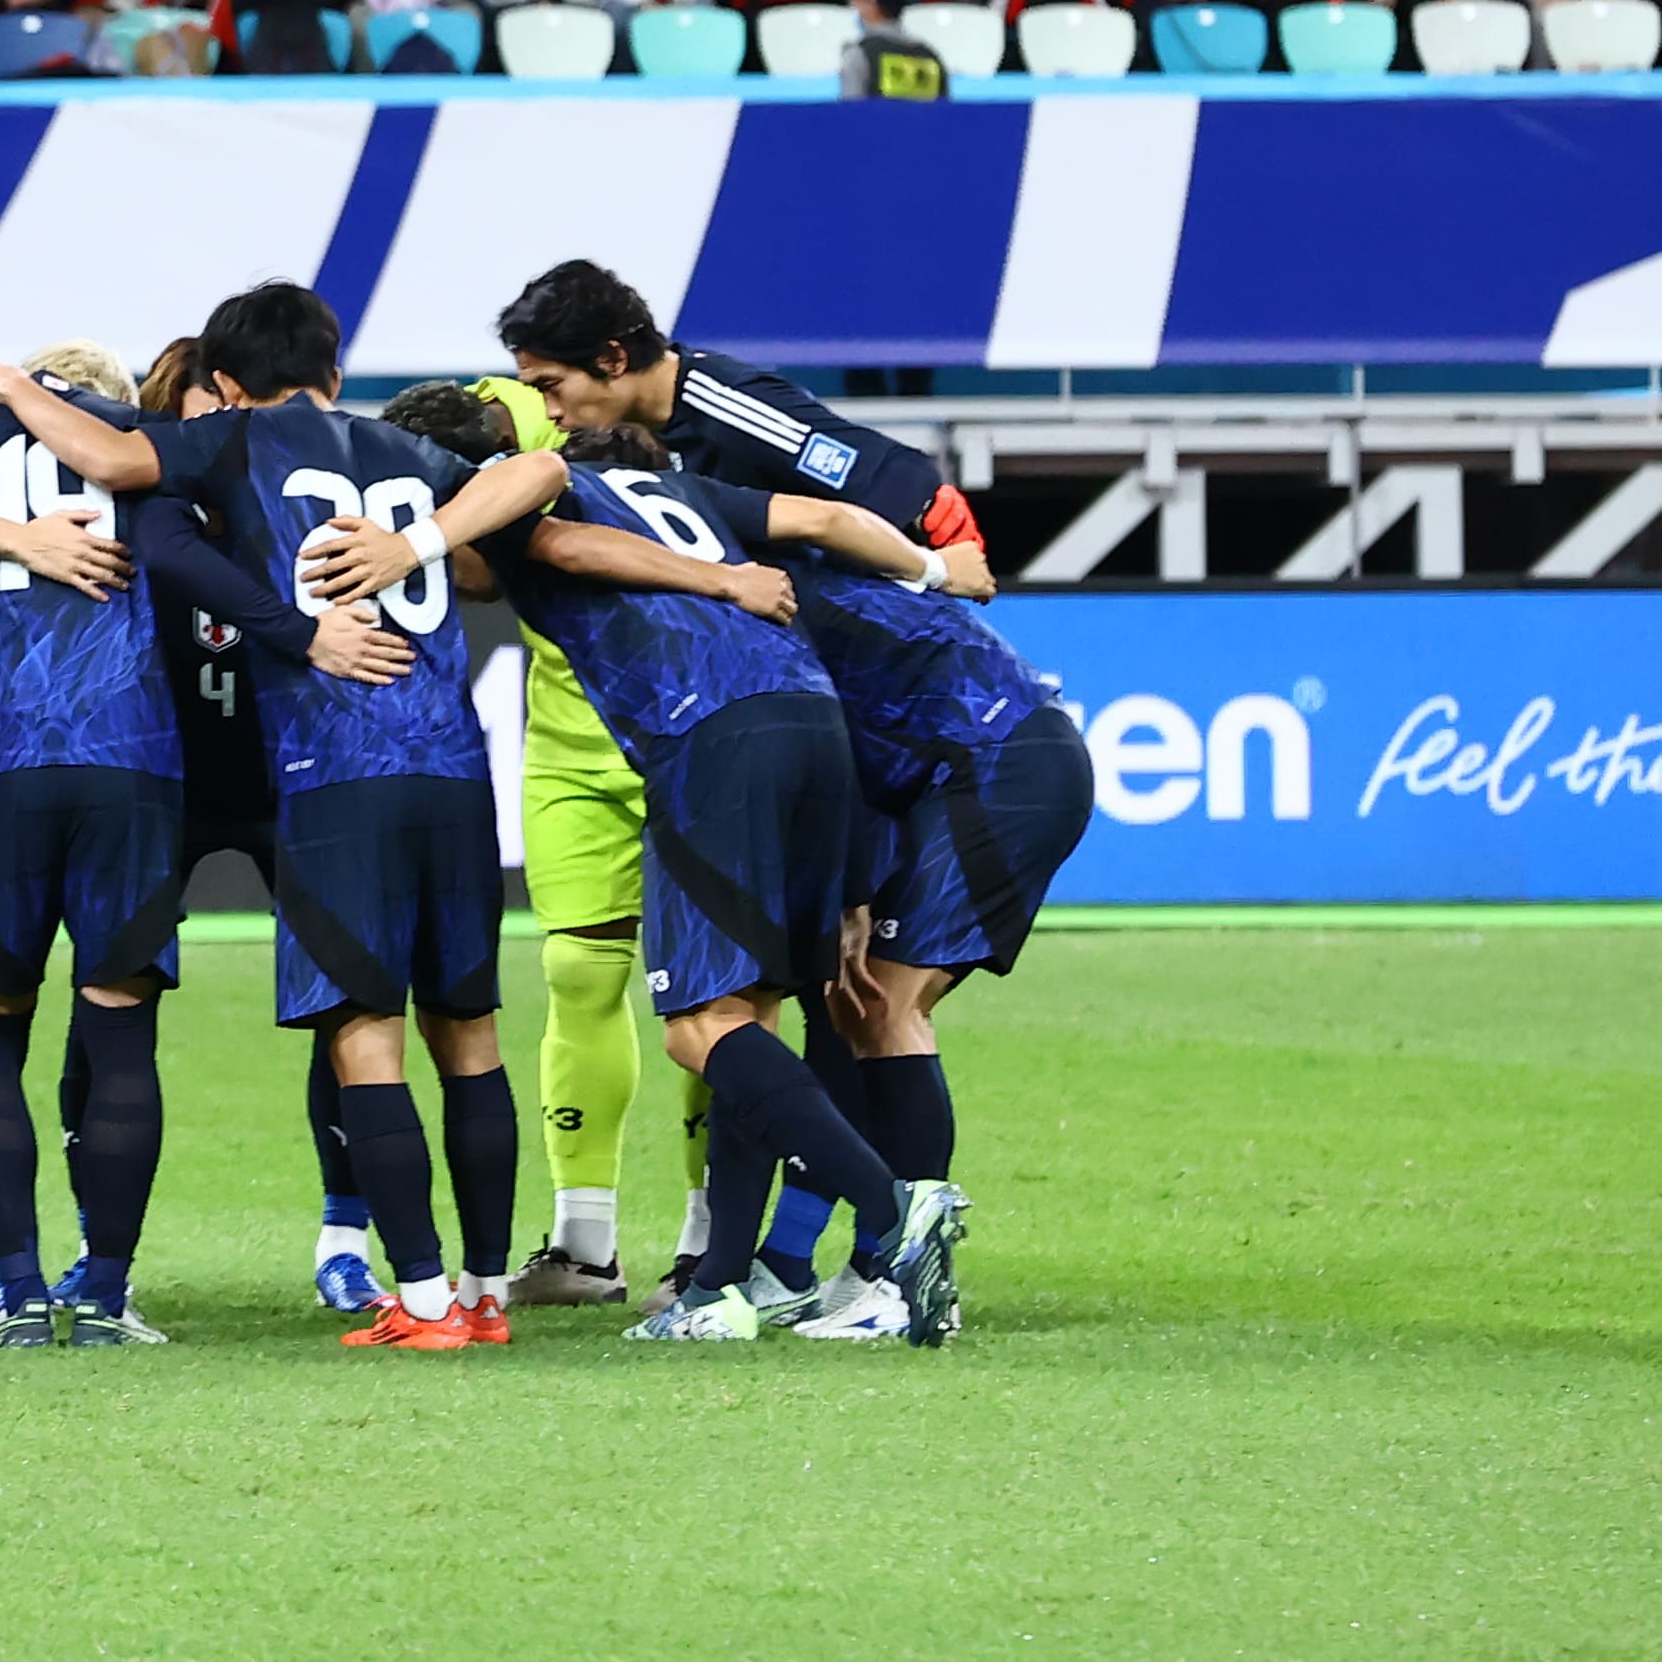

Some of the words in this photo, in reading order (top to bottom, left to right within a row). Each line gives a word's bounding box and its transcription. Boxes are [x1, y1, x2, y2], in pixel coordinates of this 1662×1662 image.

[597, 467, 726, 564] 6
[199, 662, 235, 717] 4
[1357, 694, 1556, 817] feel
